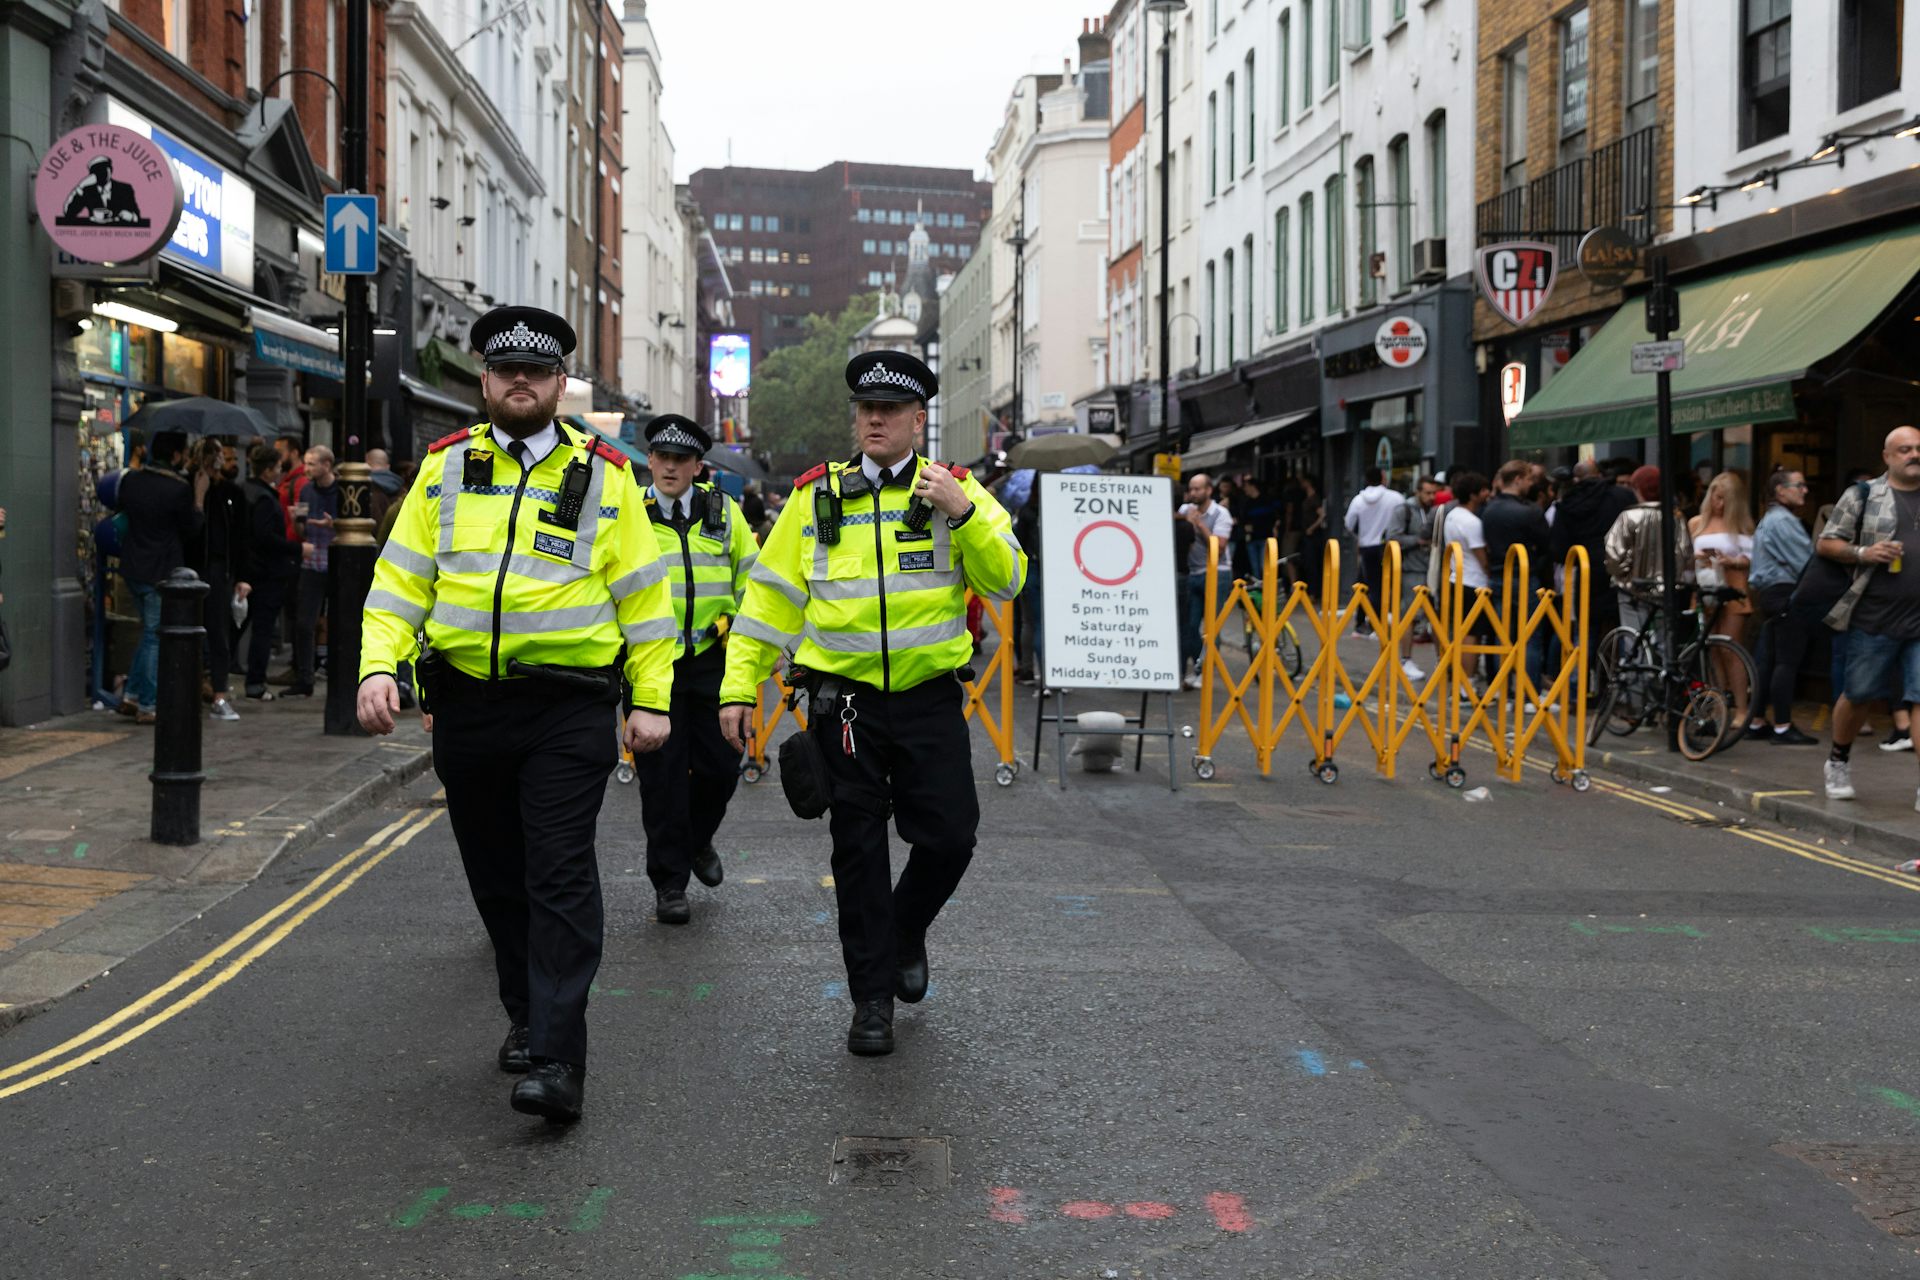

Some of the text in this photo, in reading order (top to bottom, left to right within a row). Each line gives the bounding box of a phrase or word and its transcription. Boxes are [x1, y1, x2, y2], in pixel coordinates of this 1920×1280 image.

[46, 132, 163, 182] JOE & THE JUICE
[1705, 397, 1748, 419] Kitchen
[1751, 392, 1761, 412] &
[1764, 390, 1786, 411] Bar
[1060, 482, 1153, 494] PEDESTRIAN
[1073, 498, 1139, 515] ZONE
[535, 544, 552, 553] POLICE
[1081, 589, 1110, 600] Mon
[1121, 590, 1139, 600] Fri
[1072, 603, 1080, 614] 5
[1083, 606, 1104, 616] pm
[1114, 605, 1125, 615] 11
[1128, 607, 1149, 616] pm
[1080, 621, 1142, 634] Saturday
[1064, 635, 1113, 648] Midday
[1124, 637, 1135, 647] 11
[1138, 639, 1159, 648] pm
[1087, 653, 1137, 665] Sunday
[1051, 667, 1100, 680] Midday
[1111, 669, 1151, 680] 10.30
[1153, 671, 1174, 681] pm
